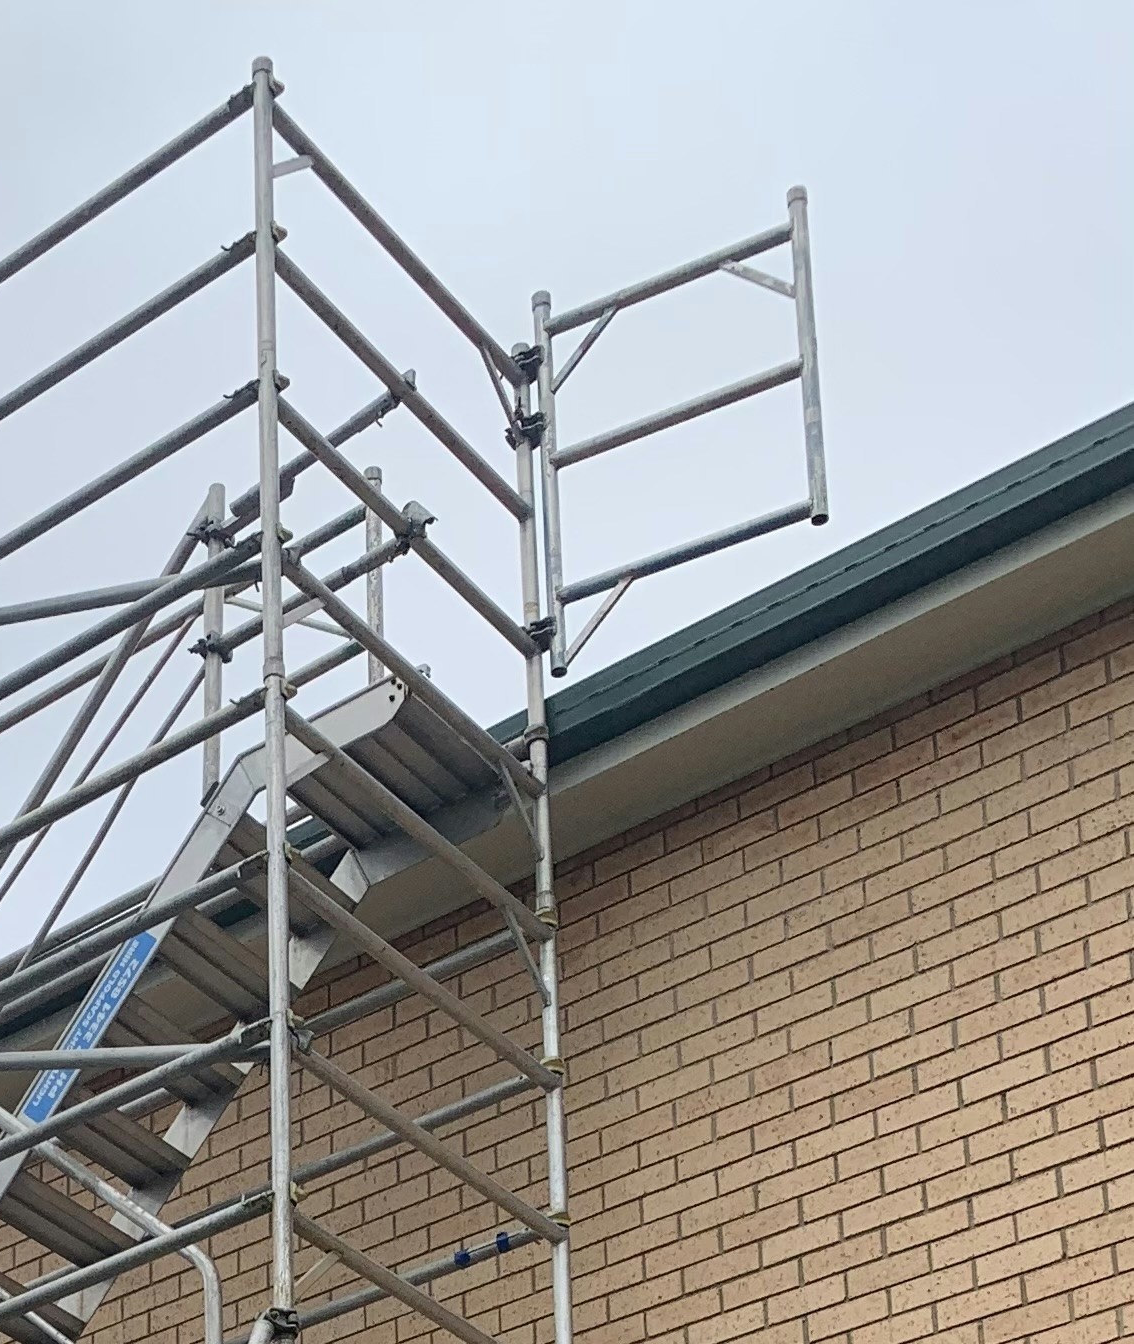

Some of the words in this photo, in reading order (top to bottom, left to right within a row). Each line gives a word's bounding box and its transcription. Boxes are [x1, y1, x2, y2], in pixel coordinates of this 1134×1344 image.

[32, 1028, 82, 1106] LIGHTGHT
[82, 969, 120, 1026] SCAFFOLD
[120, 939, 139, 966] HIRE
[48, 1072, 67, 1097] PH
[83, 1002, 110, 1041] 3341
